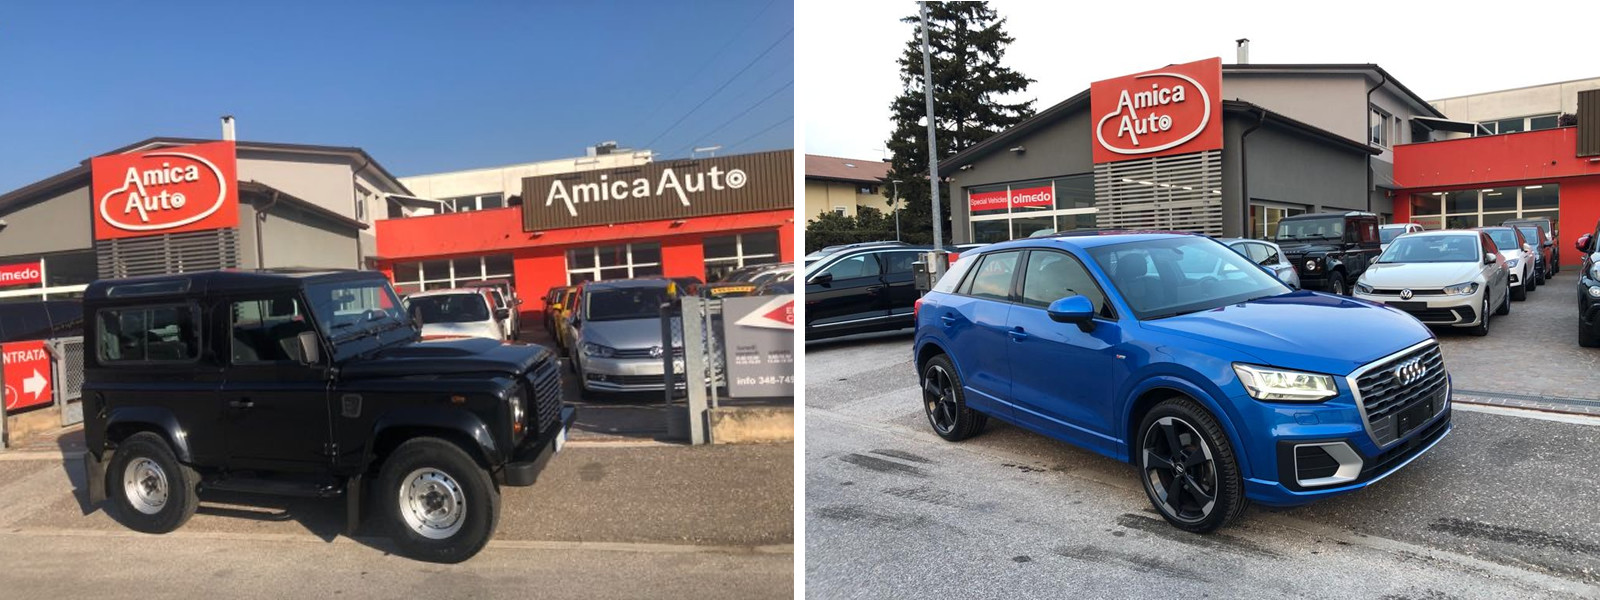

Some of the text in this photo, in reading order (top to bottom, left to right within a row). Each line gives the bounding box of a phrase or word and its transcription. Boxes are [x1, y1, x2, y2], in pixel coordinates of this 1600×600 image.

[1117, 83, 1185, 120] Amica
[1117, 112, 1173, 146] Auto
[123, 162, 199, 197] Amica
[545, 166, 747, 216] Amica Auto
[124, 190, 186, 222] Auto
[1012, 191, 1051, 204] olmedo
[736, 376, 756, 385] info
